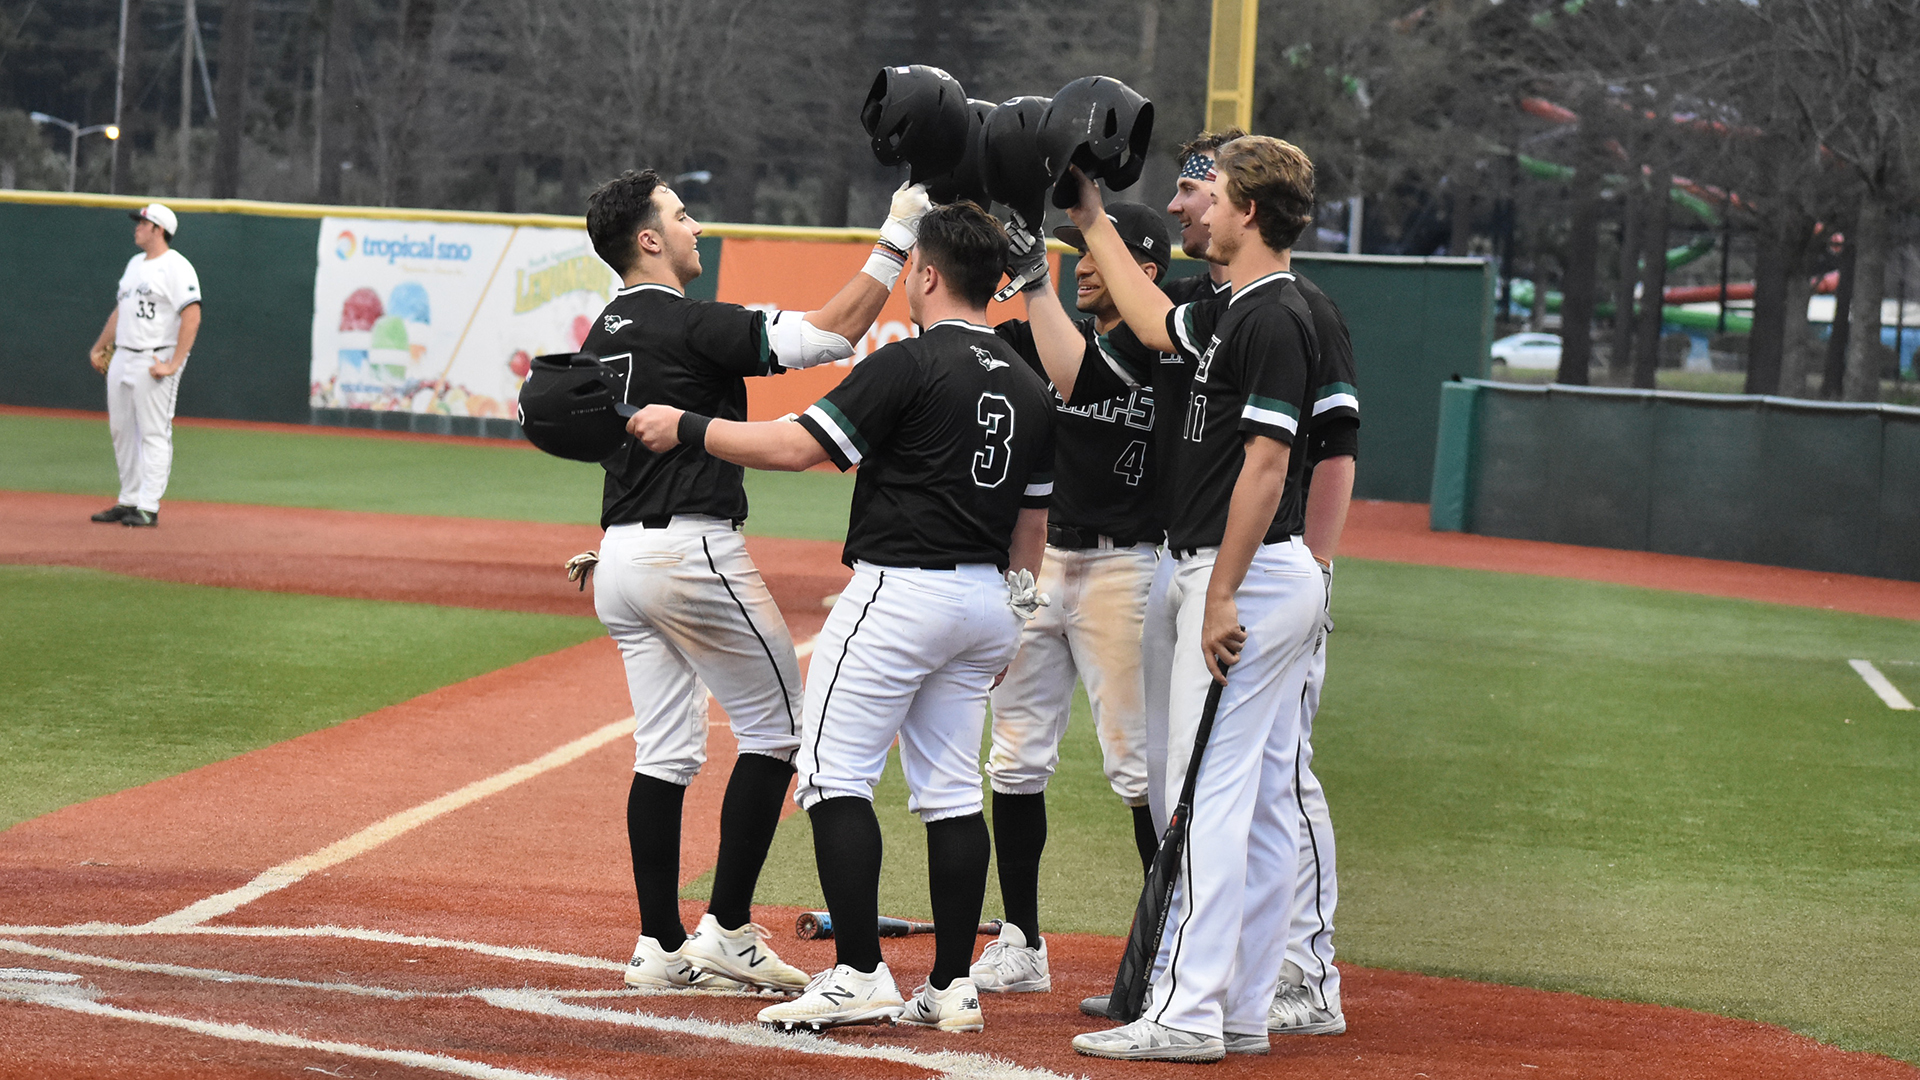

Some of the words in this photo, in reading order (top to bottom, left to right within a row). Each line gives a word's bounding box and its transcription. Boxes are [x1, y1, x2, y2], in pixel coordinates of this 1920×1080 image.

[362, 233, 434, 265] tropical
[437, 242, 473, 261] sno
[136, 300, 156, 319] 33
[971, 392, 1014, 488] 3
[1113, 440, 1147, 486] 4
